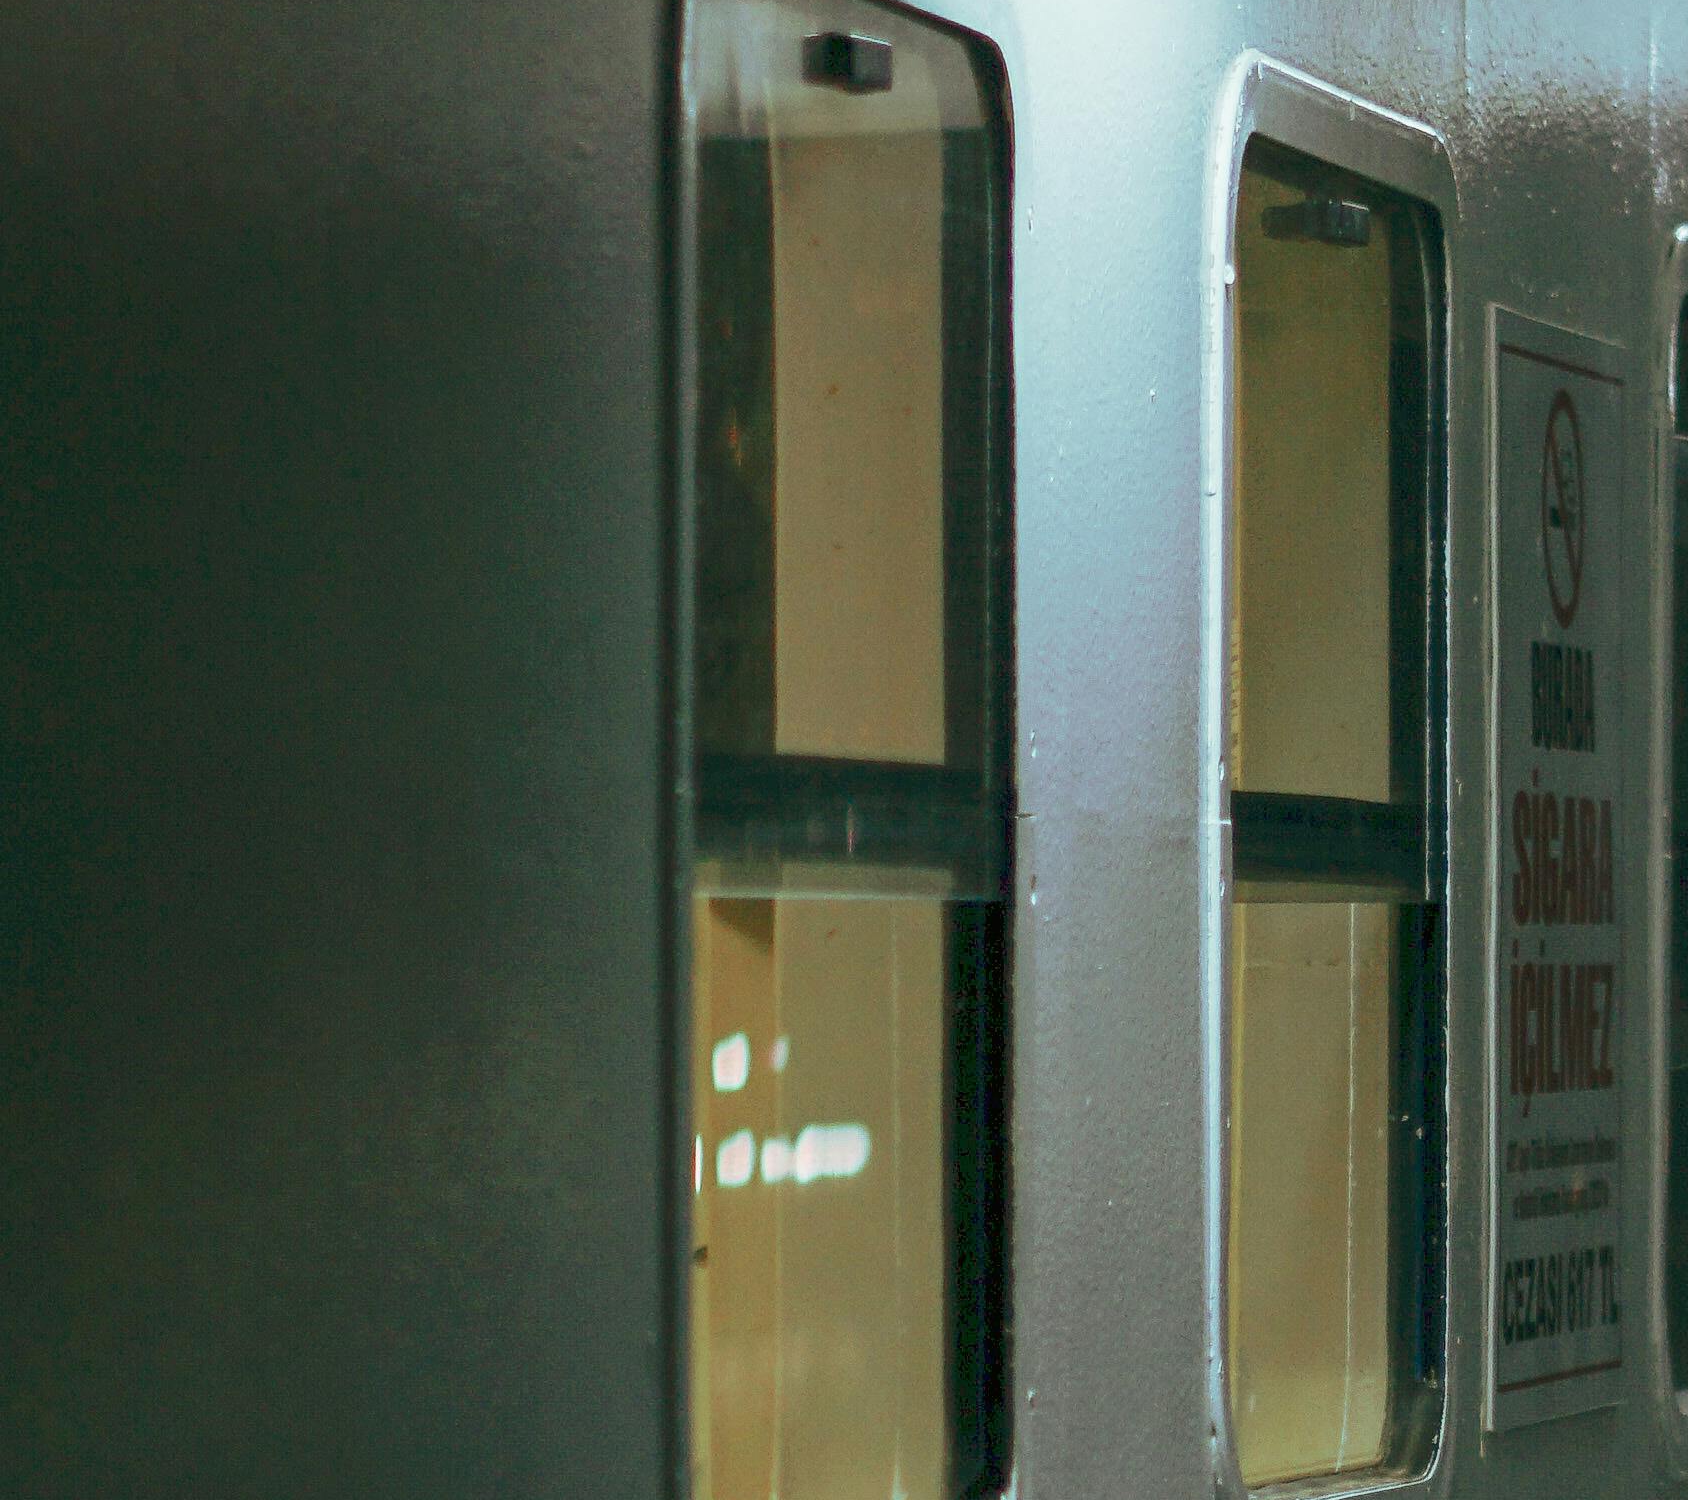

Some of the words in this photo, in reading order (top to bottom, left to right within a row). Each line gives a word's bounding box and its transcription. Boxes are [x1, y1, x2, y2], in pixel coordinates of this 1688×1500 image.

[1512, 767, 1614, 925] SİGARA
[1510, 940, 1614, 1117] İÇİLMEZ
[1503, 1253, 1562, 1345] CEZASI
[1599, 1245, 1618, 1325] TL
